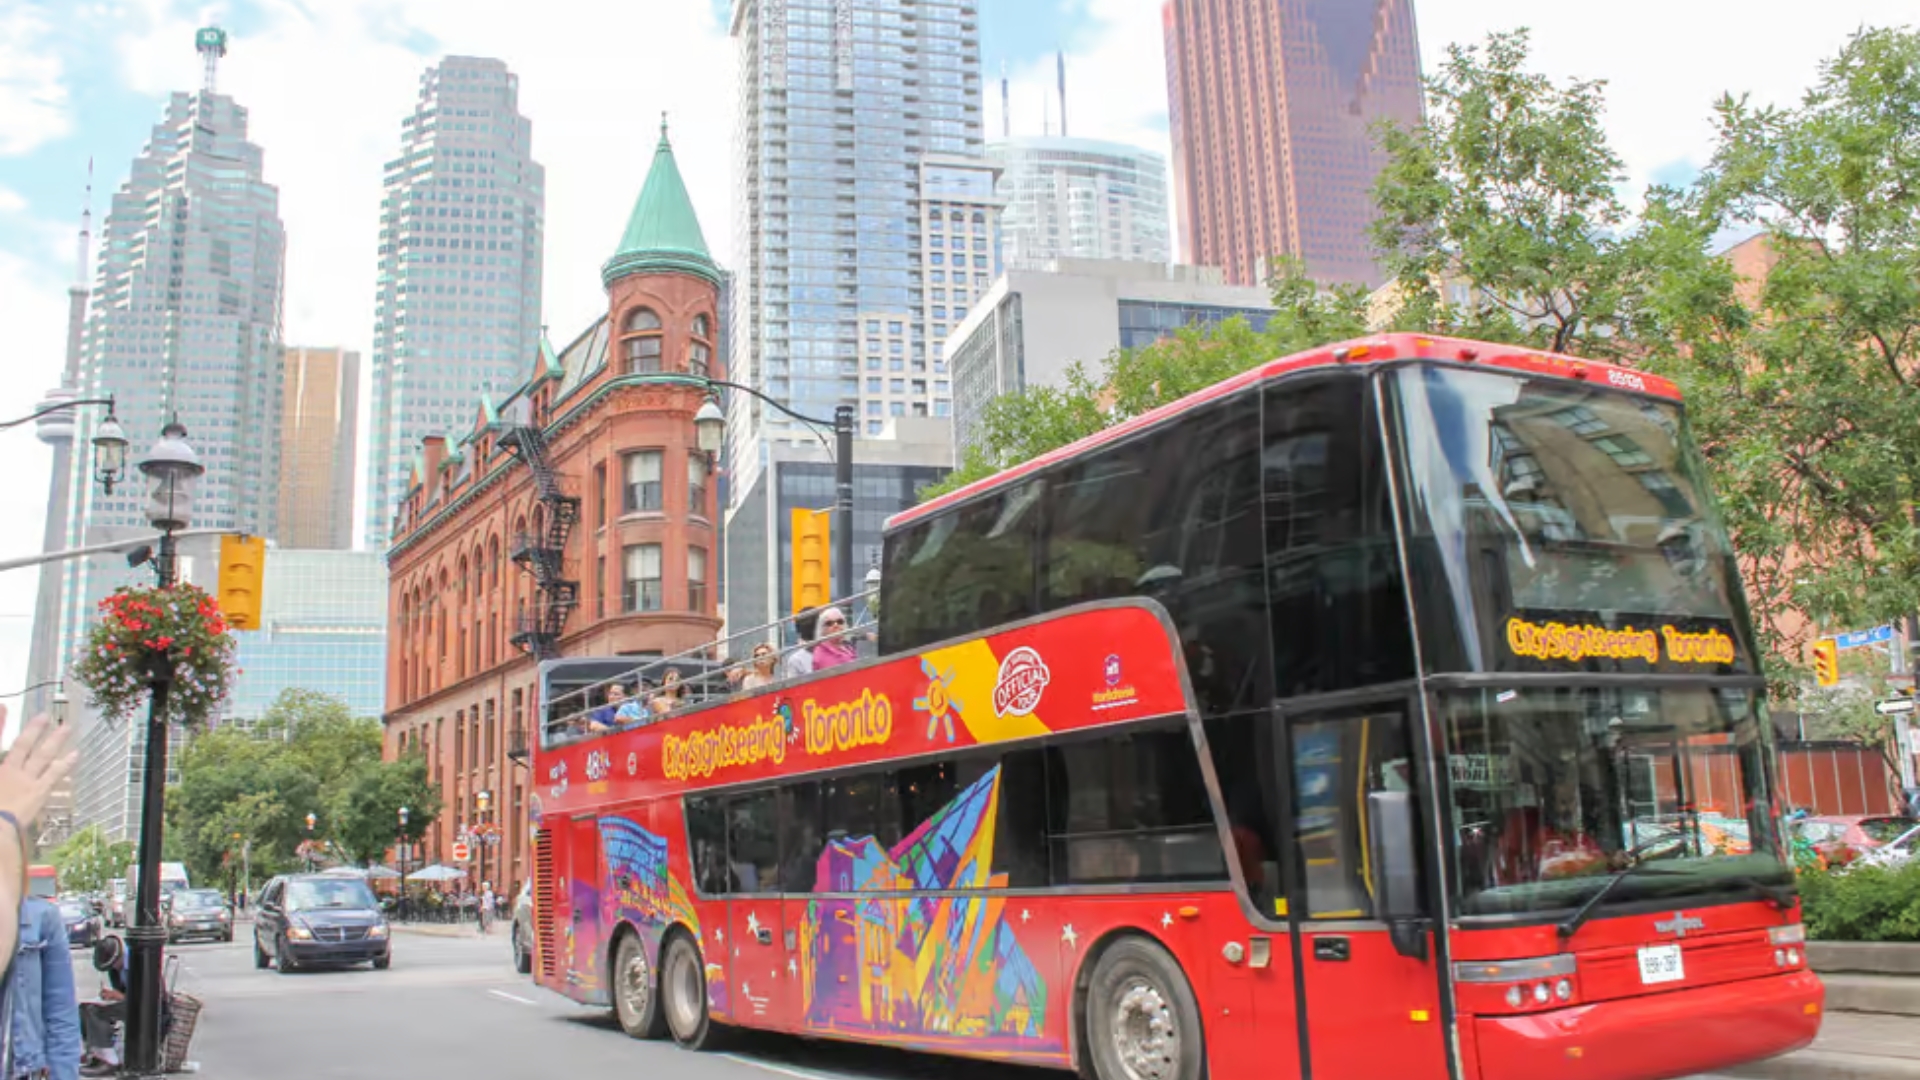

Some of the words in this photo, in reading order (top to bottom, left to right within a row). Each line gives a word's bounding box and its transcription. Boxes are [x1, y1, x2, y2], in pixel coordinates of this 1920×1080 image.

[1662, 624, 1734, 664] Toronto
[997, 667, 1047, 707] OFFICIAL
[662, 715, 785, 780] CitySightseeing
[802, 687, 892, 754] Toronto
